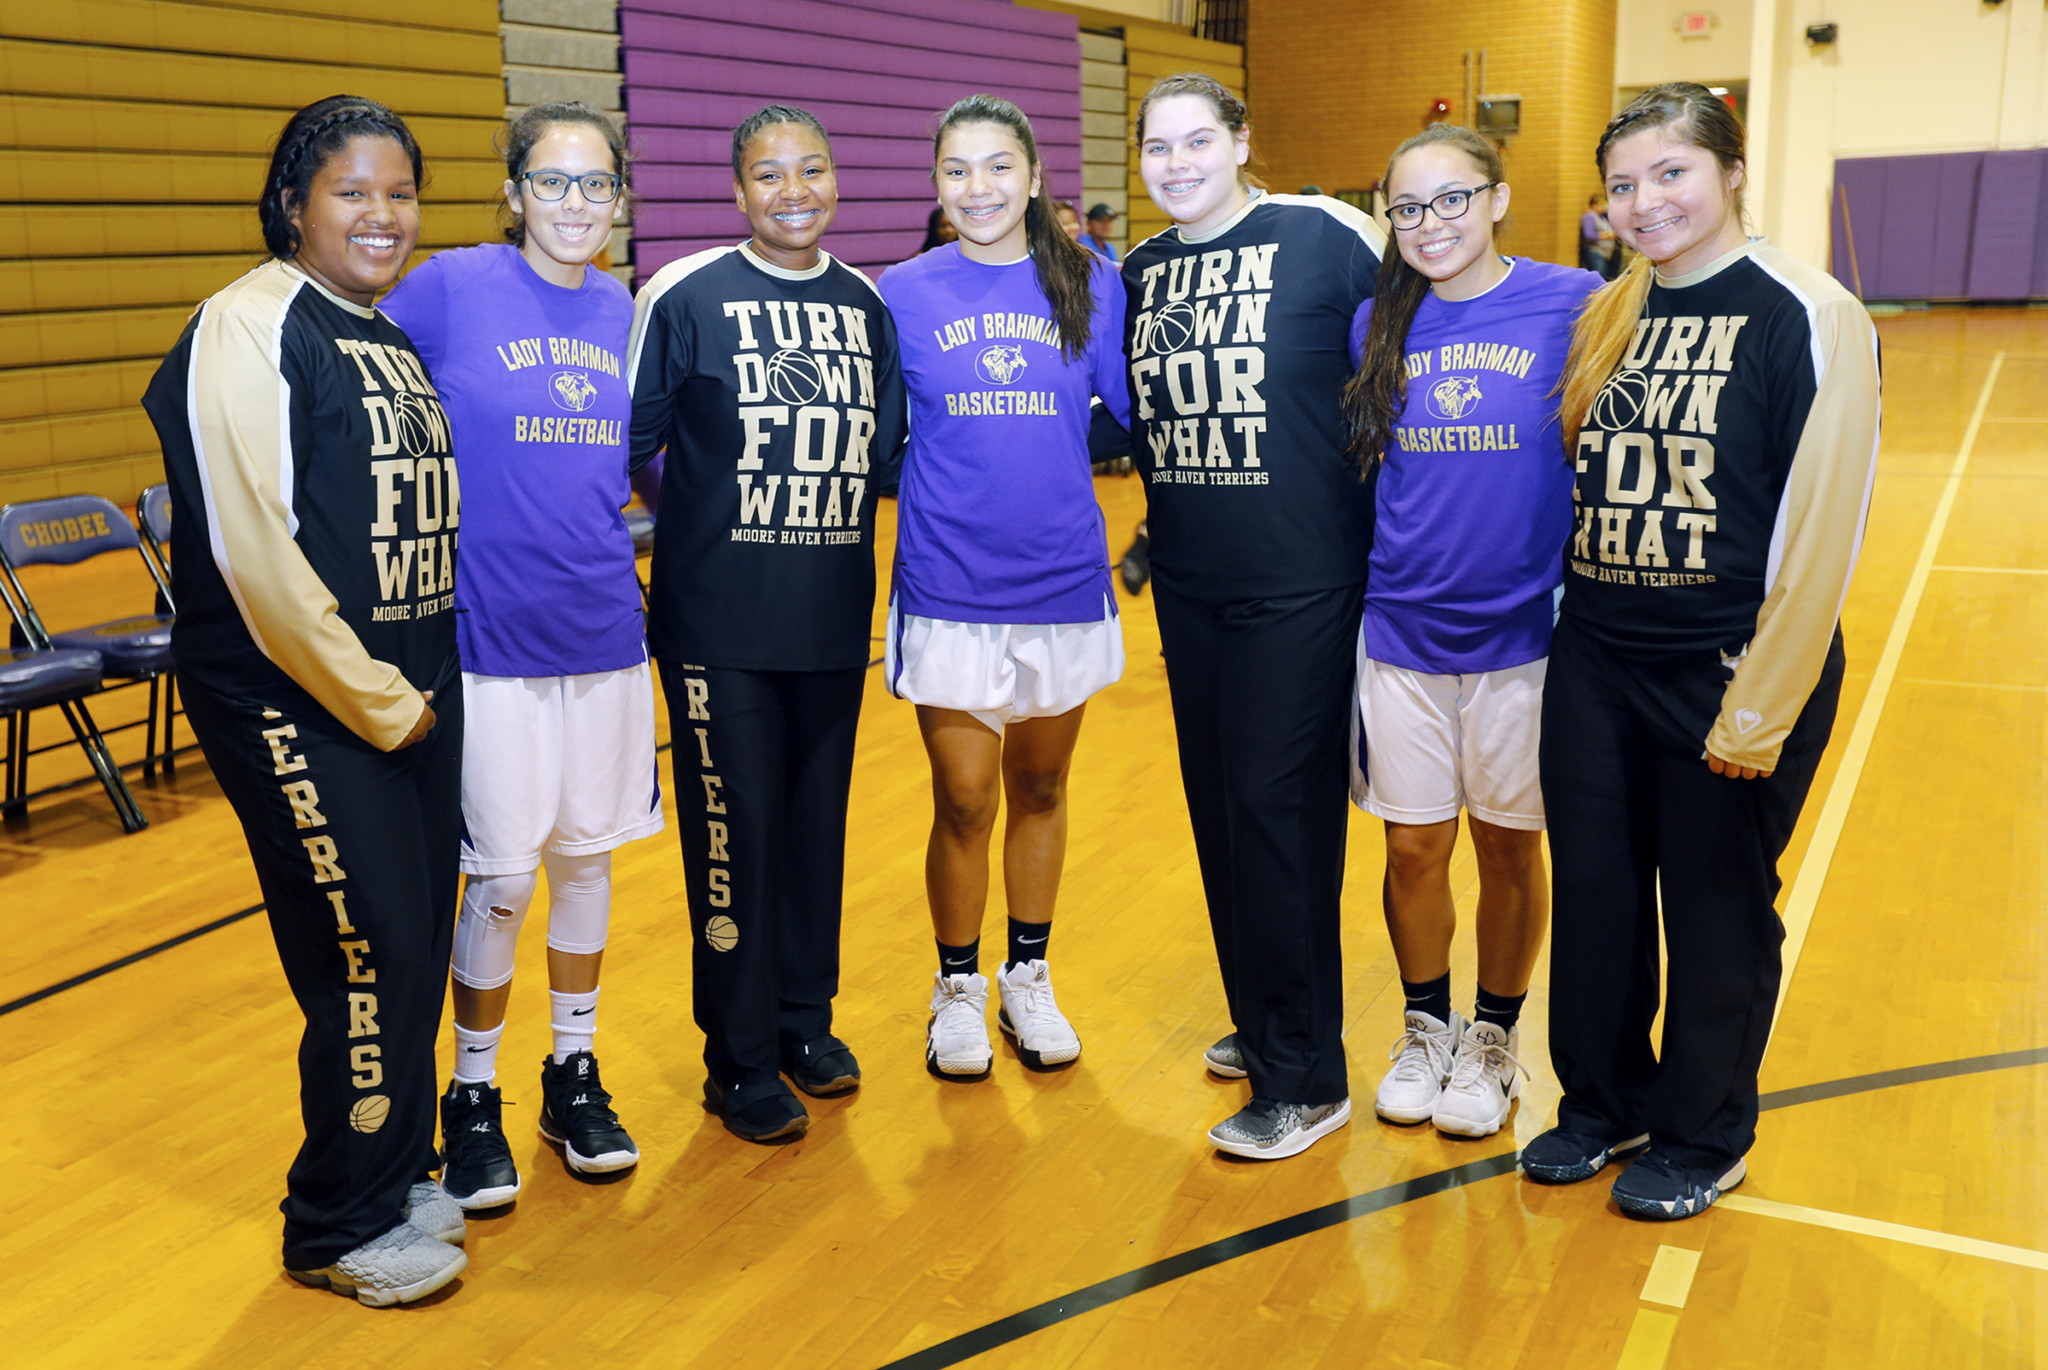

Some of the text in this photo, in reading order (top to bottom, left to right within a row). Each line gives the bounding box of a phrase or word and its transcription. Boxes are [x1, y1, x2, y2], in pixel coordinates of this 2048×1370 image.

[1141, 243, 1280, 310] TURN
[722, 300, 873, 357] TURN
[934, 316, 977, 352] LADY
[1622, 315, 1750, 372] URN
[496, 337, 620, 379] LADY BRAHMAN
[1131, 346, 1267, 421] FOR
[1402, 342, 1537, 381] ADY BRAHMAN
[944, 390, 1058, 416] BASKETBALL
[1579, 369, 1728, 435] OWN
[515, 415, 622, 446] BASKETBALL
[737, 405, 877, 475] FOR
[1147, 416, 1268, 468] WHAT
[1397, 424, 1520, 453] BASKETBALL
[1175, 471, 1206, 485] HAVEN
[1209, 472, 1270, 485] TERRIERS
[1572, 430, 1717, 510] FOR
[736, 474, 867, 528] WHAT
[19, 511, 111, 549] CHOBEE
[730, 529, 861, 545] MOORE HAVEN TERRIERS
[371, 532, 459, 601] WHA
[1598, 565, 1637, 586] HAVEN
[1641, 571, 1717, 587] TERRIERS
[371, 604, 411, 622] MOORE
[416, 598, 439, 620] AVEN
[683, 664, 731, 908] RIERS
[262, 706, 383, 1089] ERRIERS
